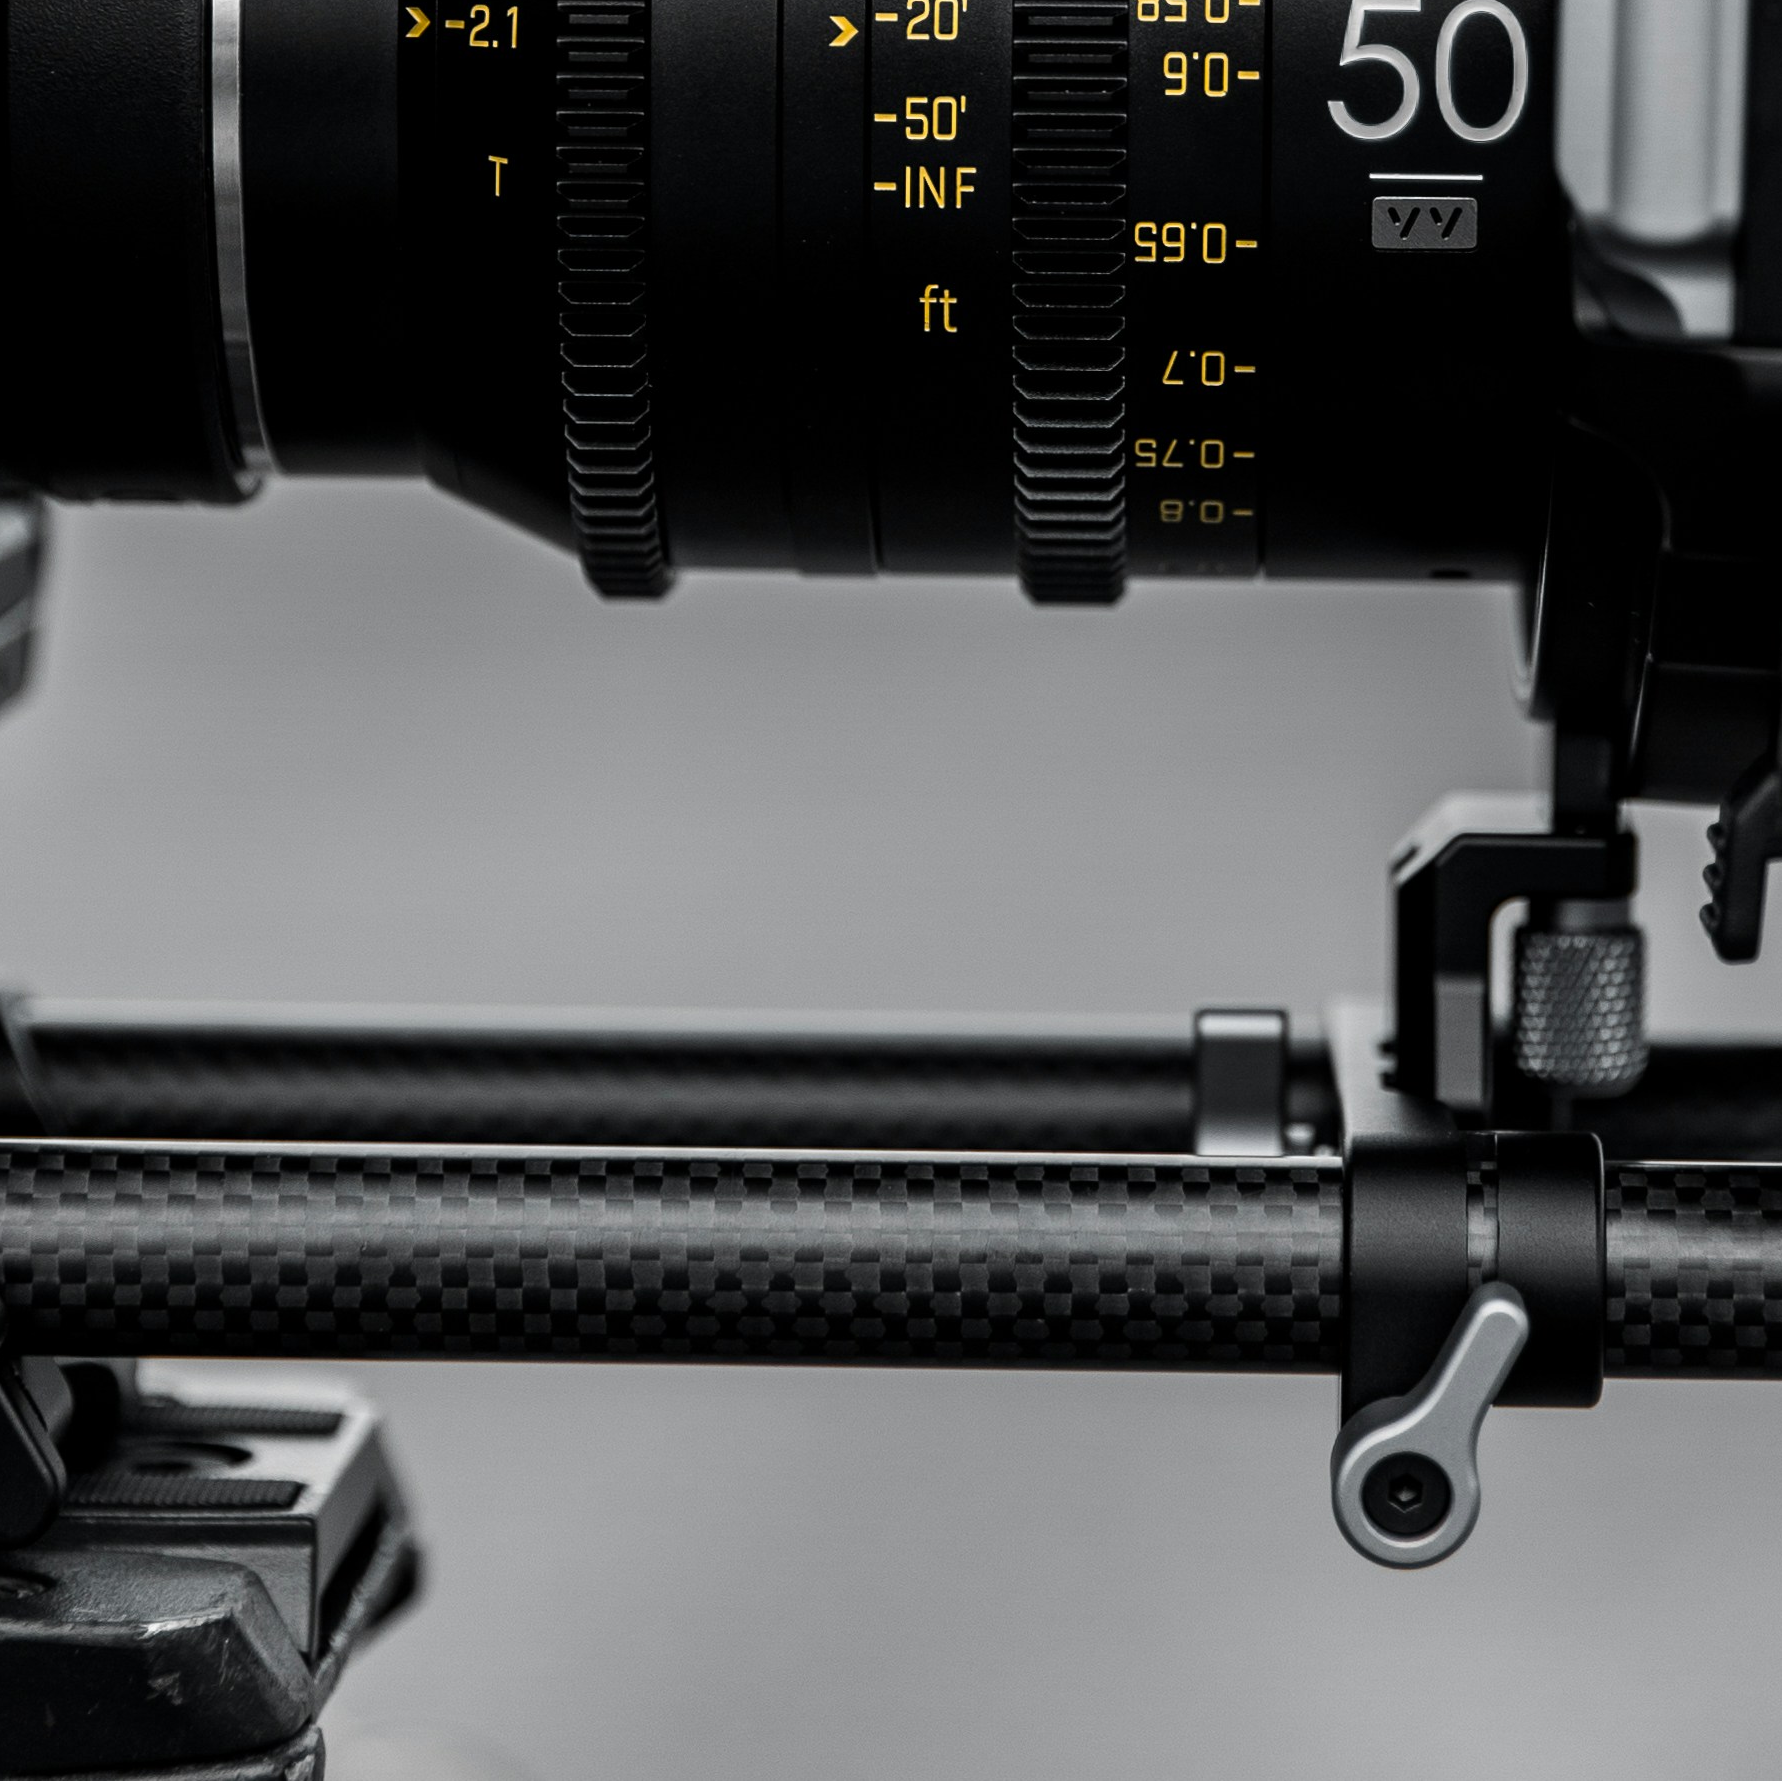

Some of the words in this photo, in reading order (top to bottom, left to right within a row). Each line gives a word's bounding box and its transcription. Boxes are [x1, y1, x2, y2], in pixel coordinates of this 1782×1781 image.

[468, 4, 519, 49] 2.1
[1162, 51, 1229, 98] 0.6
[904, 94, 967, 141] 50'
[489, 154, 509, 197] T
[904, 165, 978, 208] INF
[1134, 221, 1227, 265] 0.65
[918, 283, 958, 333] ft
[1162, 350, 1226, 387] 0.7
[1134, 438, 1225, 469] 0.75
[1160, 500, 1224, 523] 0.8
